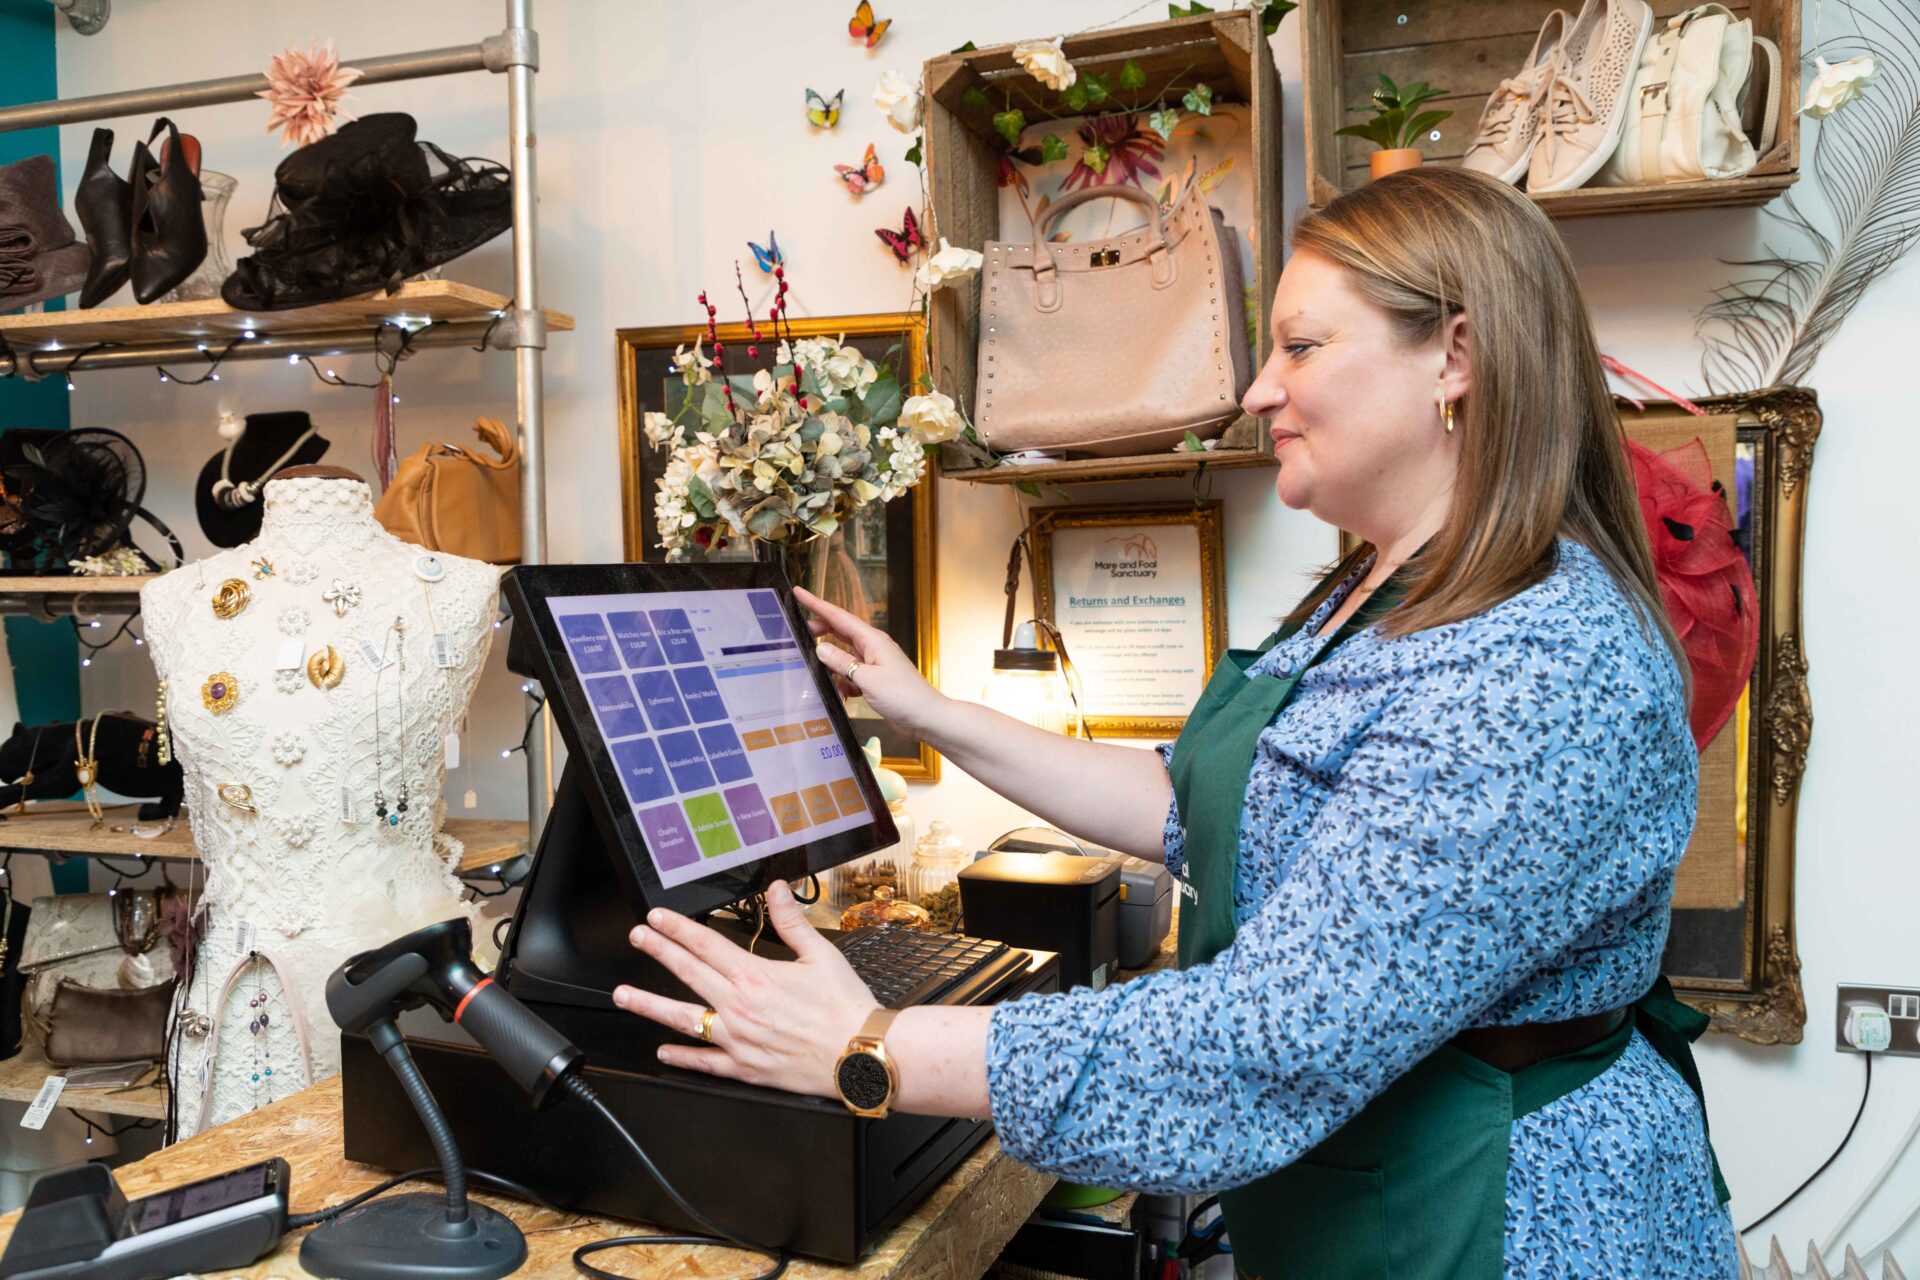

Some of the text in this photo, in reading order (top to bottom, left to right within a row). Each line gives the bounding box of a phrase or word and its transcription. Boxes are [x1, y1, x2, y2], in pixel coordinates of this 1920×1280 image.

[1095, 559, 1157, 570] Mare and Foal
[1110, 569, 1157, 578] Sanctuary
[1070, 595, 1186, 607] Returns and Exchanges
[568, 635, 595, 643] Jewellery
[702, 690, 717, 698] Media
[598, 701, 634, 712] Memorabilia
[648, 696, 675, 706] Ephemera
[820, 743, 844, 760] £0.00
[668, 758, 693, 769] Valuables
[632, 766, 654, 776] Vintage
[657, 825, 678, 837] Charity
[659, 836, 685, 849] Donation
